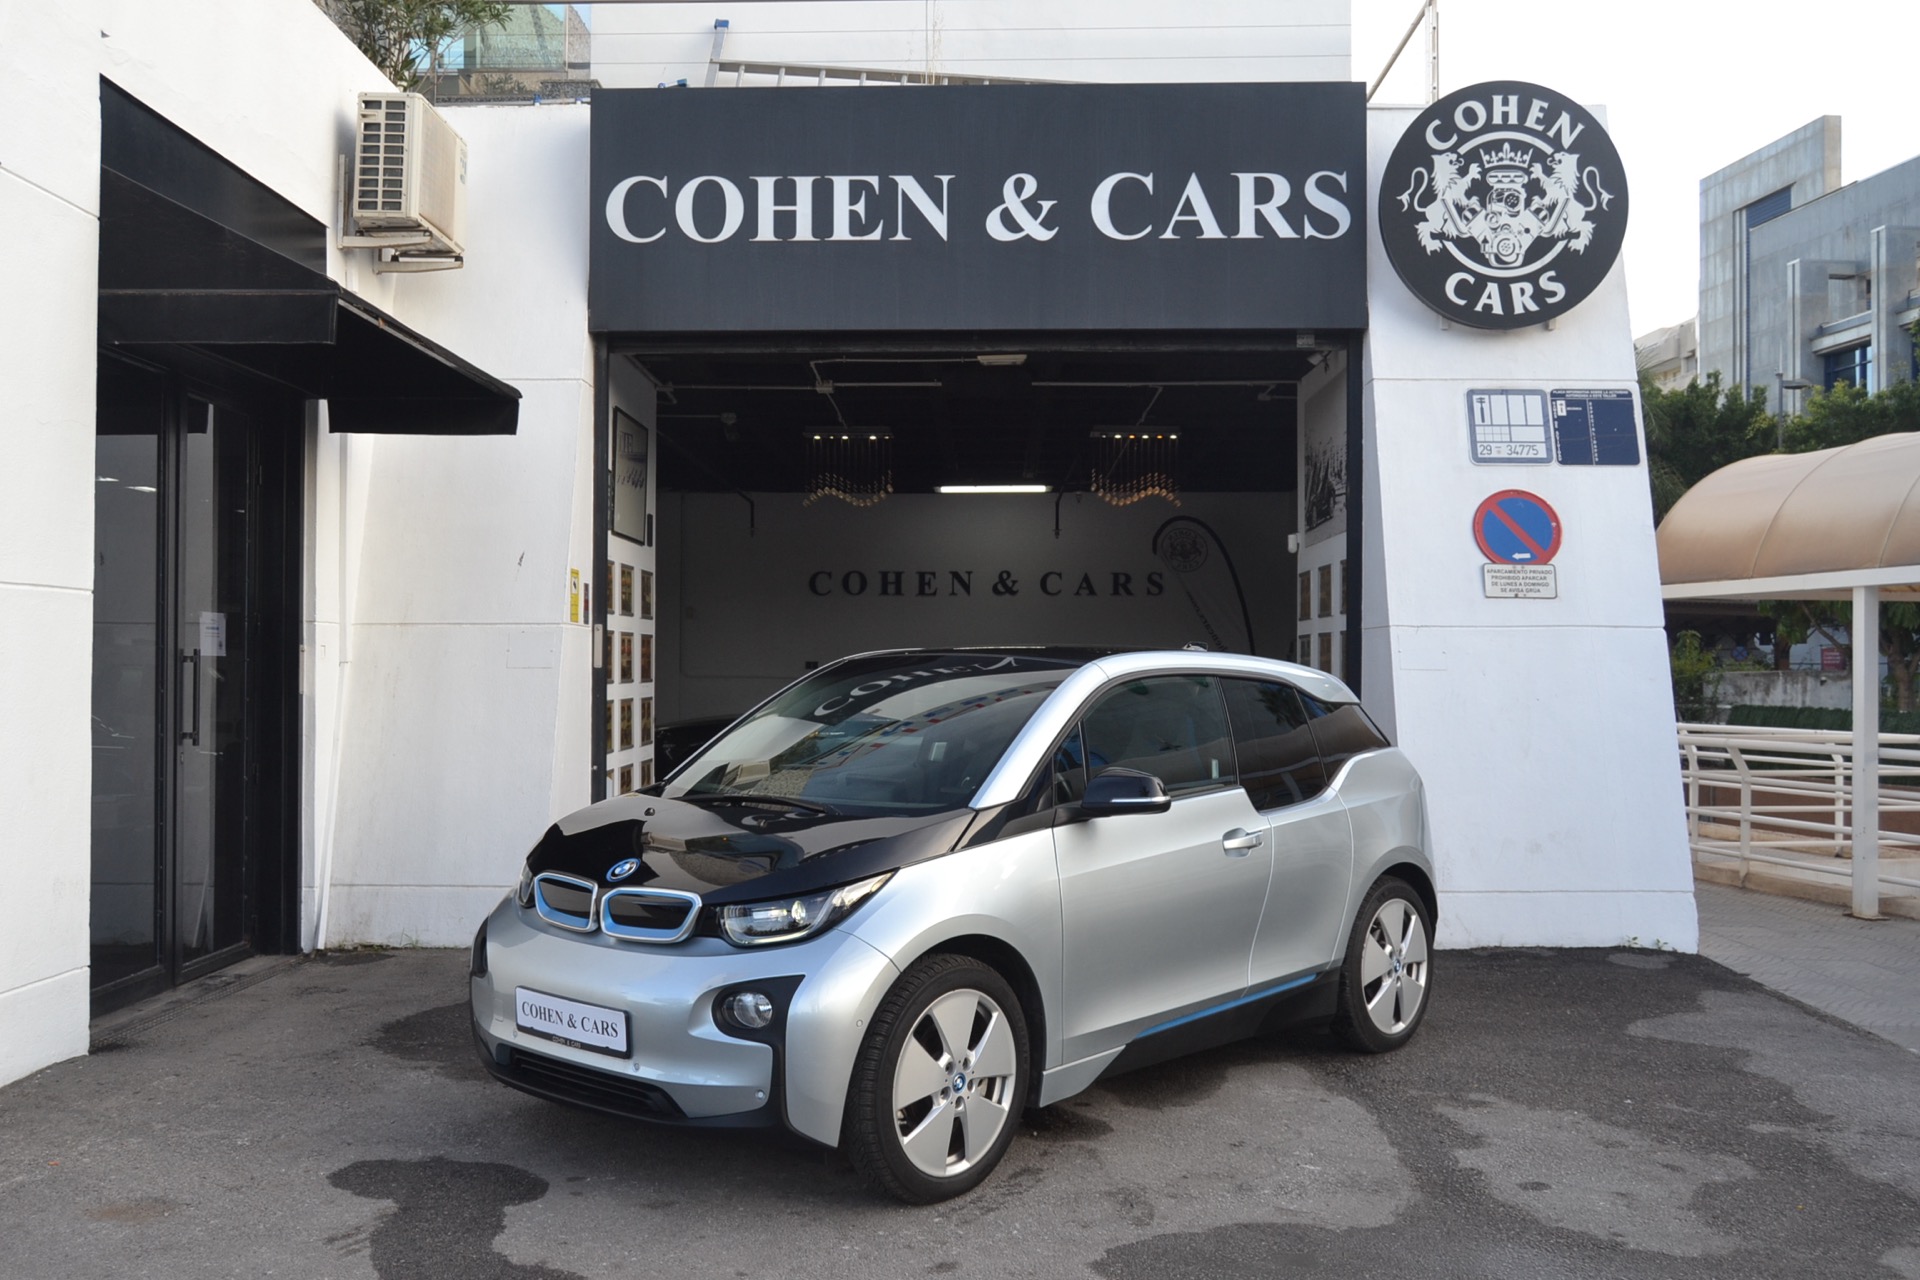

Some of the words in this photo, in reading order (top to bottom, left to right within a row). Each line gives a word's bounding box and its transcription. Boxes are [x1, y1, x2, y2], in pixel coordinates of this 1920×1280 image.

[1425, 94, 1585, 150] COHEN
[604, 174, 956, 244] COHEN
[985, 172, 1059, 243] &
[1090, 170, 1353, 241] CARS
[1445, 270, 1566, 315] CARS
[1479, 444, 1492, 456] 29
[1506, 444, 1539, 456] 34775
[808, 570, 973, 598] COHEN
[991, 570, 1019, 598] &
[1039, 571, 1165, 598] CARS
[521, 1001, 564, 1026] COHEN
[567, 1013, 577, 1030] &
[580, 1016, 619, 1038] CARS
